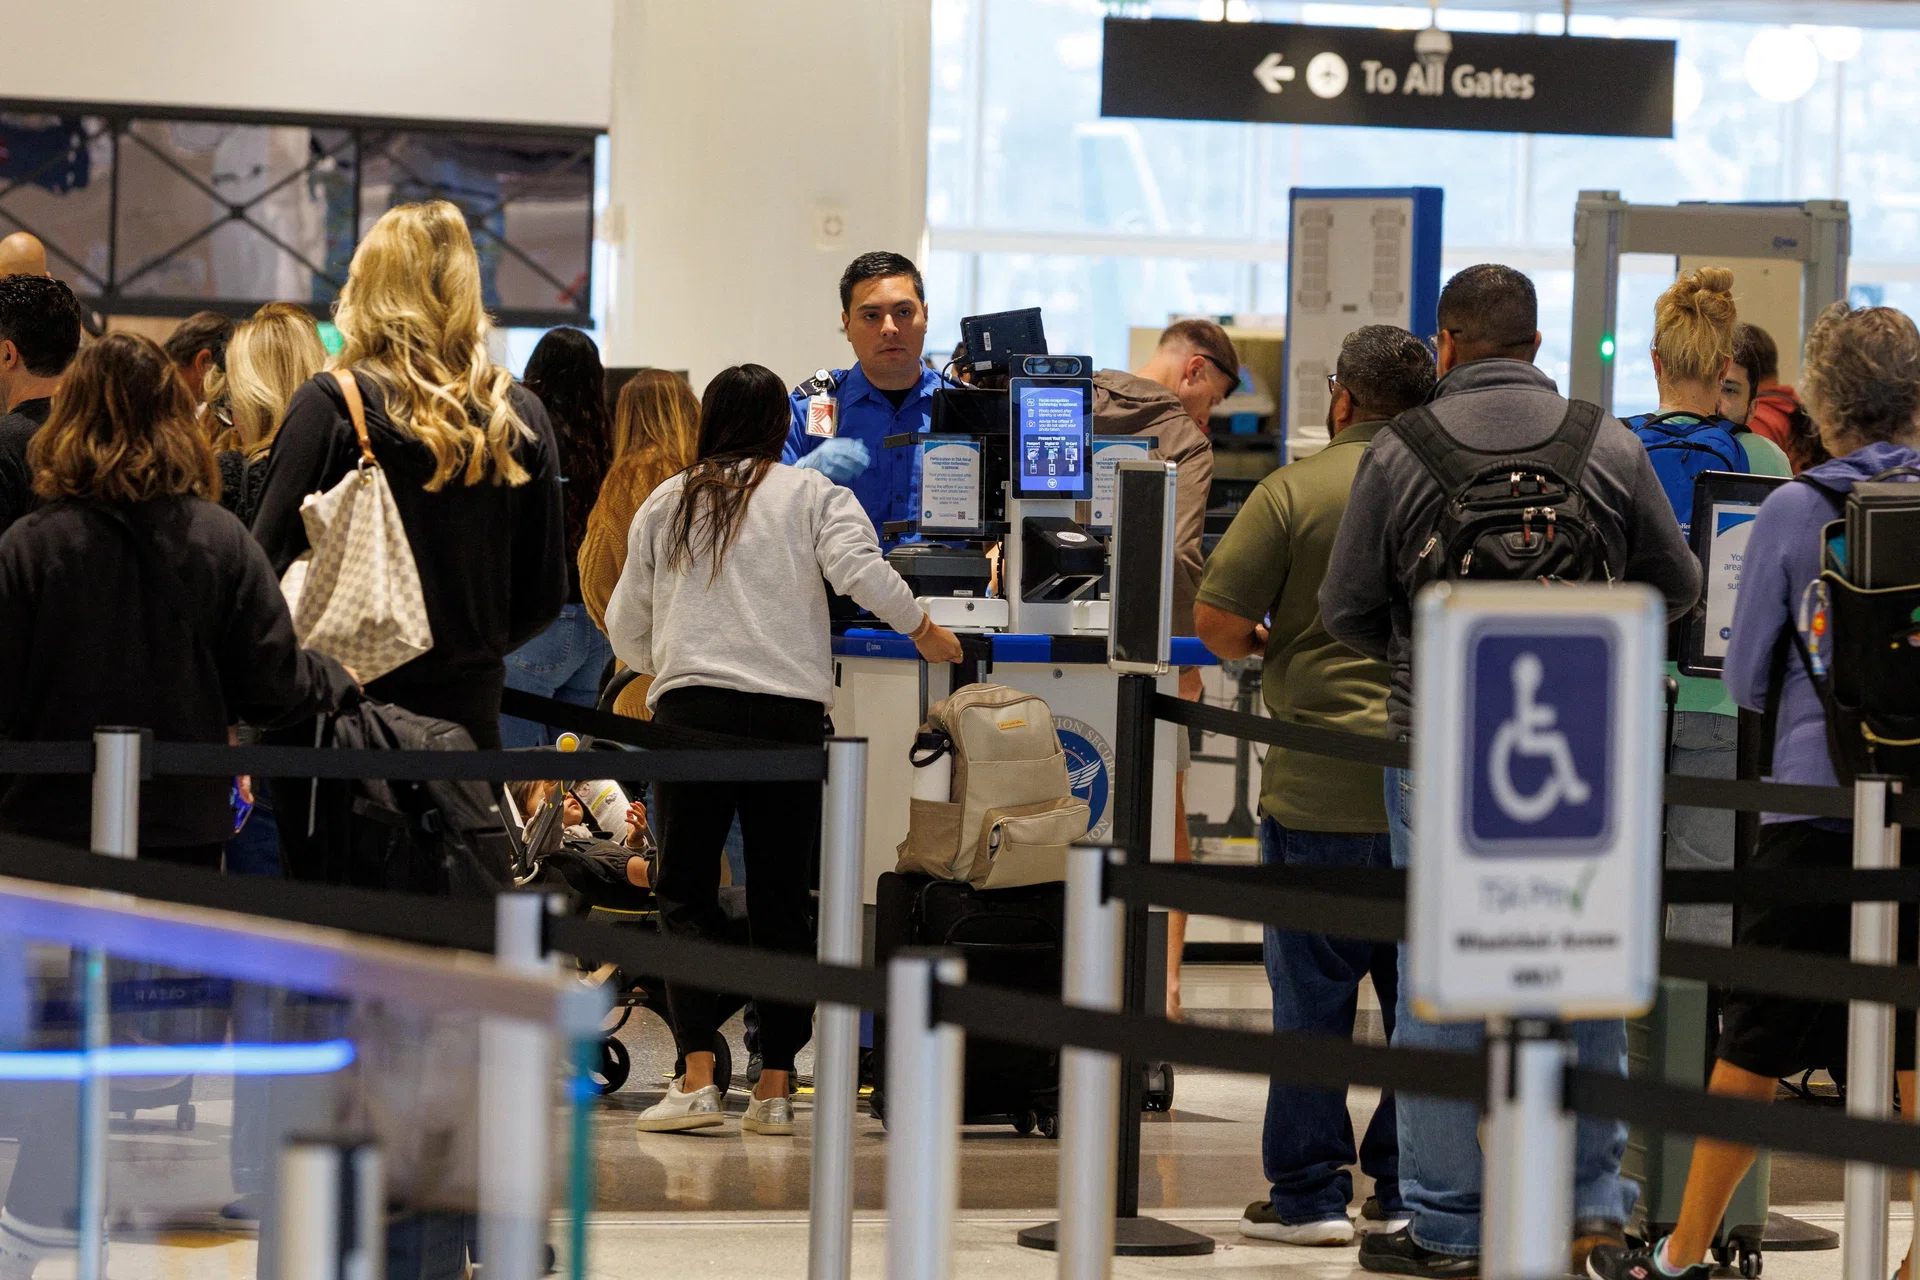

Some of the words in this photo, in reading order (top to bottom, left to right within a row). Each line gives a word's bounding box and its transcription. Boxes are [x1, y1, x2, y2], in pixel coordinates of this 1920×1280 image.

[1361, 60, 1396, 95] To
[1403, 61, 1445, 97] All
[1452, 64, 1536, 100] Gates
